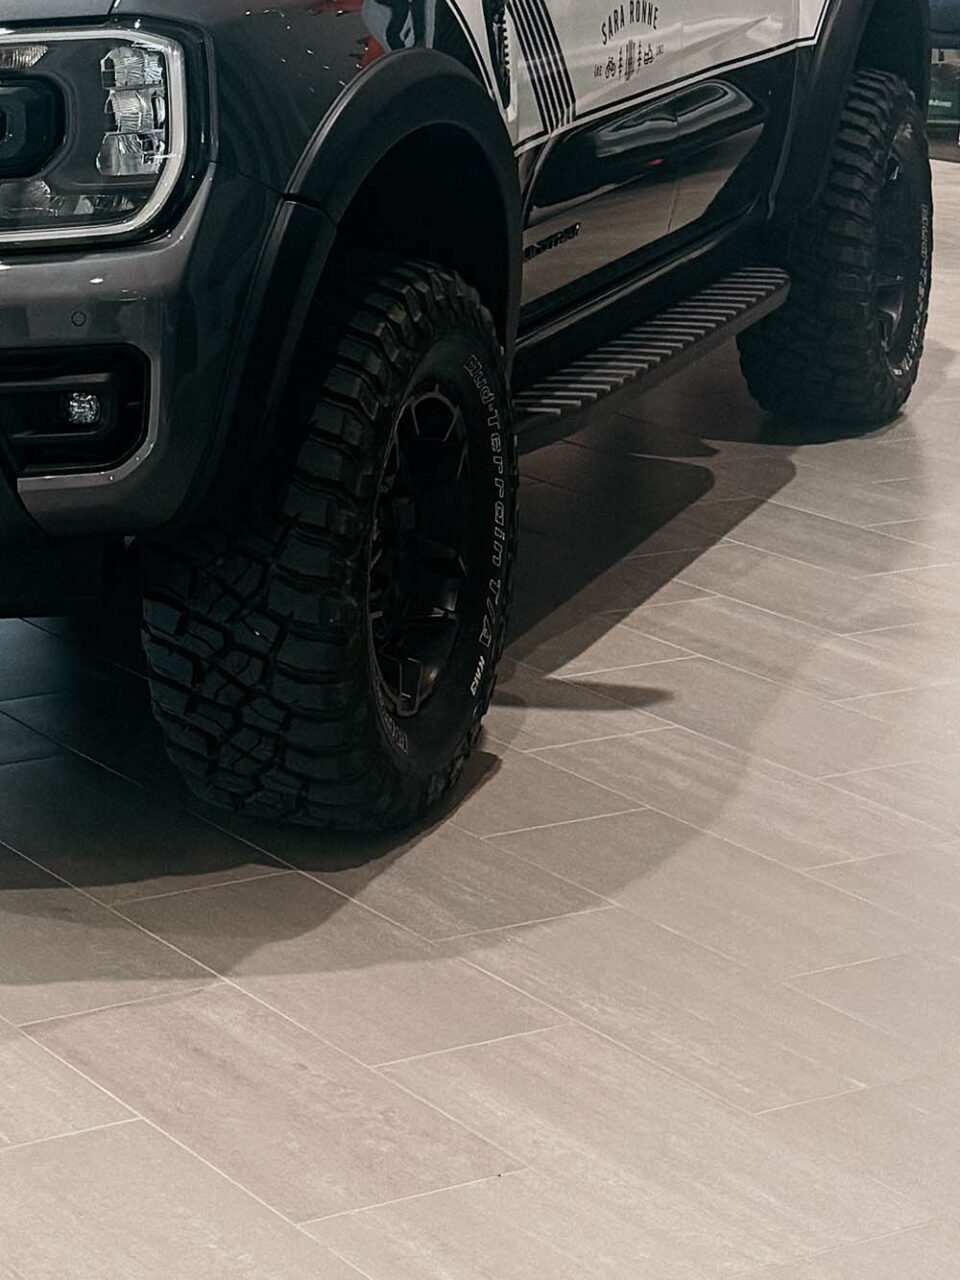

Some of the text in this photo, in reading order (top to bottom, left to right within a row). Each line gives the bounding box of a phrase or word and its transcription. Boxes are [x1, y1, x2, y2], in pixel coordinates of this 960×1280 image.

[601, 4, 625, 46] SARA
[463, 354, 506, 568] Mud-Terrain
[479, 579, 501, 648] T/A
